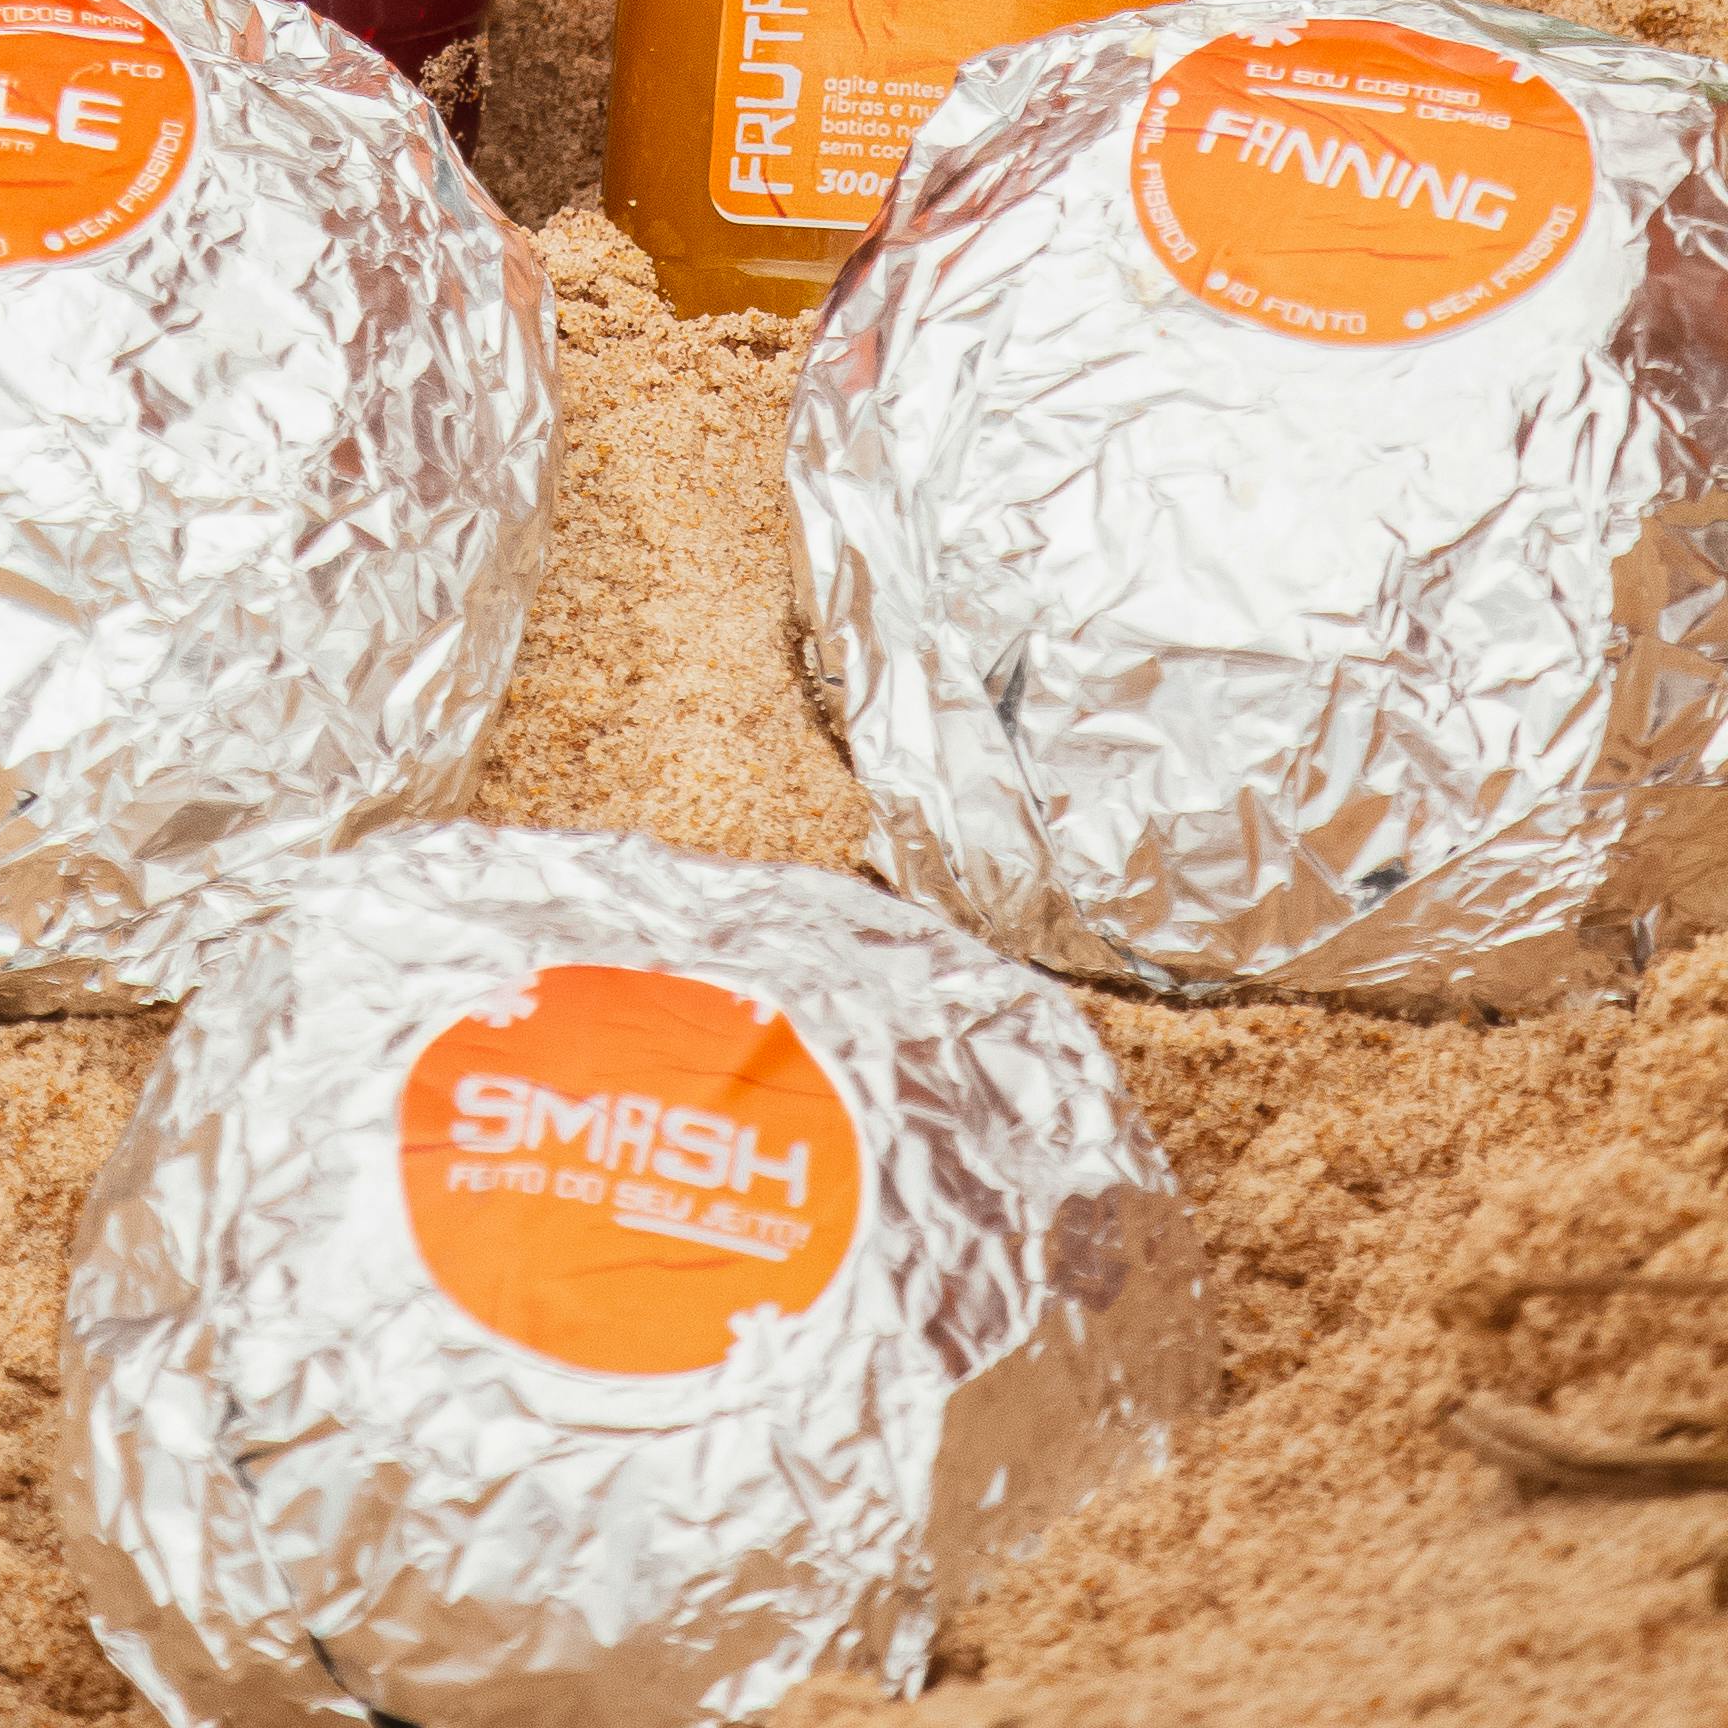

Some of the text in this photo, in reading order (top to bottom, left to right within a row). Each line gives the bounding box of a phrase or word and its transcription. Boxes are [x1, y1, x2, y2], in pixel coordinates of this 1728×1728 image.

[822, 94, 885, 116] fibras
[888, 103, 904, 117] e
[823, 75, 945, 100] agite antes
[1245, 62, 1481, 107] EU SOU GOSTOSO
[820, 115, 891, 137] batido
[1138, 107, 1169, 154] MAL
[1415, 103, 1512, 131] DEMAIS
[116, 120, 185, 214] PASSADO
[818, 140, 909, 160] sem coa
[1197, 109, 1517, 232] FANNING
[1224, 280, 1367, 335] AO PONTO
[450, 1073, 810, 1208] SMASH
[447, 1161, 547, 1194] FEITO
[554, 1171, 606, 1205] DO
[613, 1182, 697, 1221] SEU
